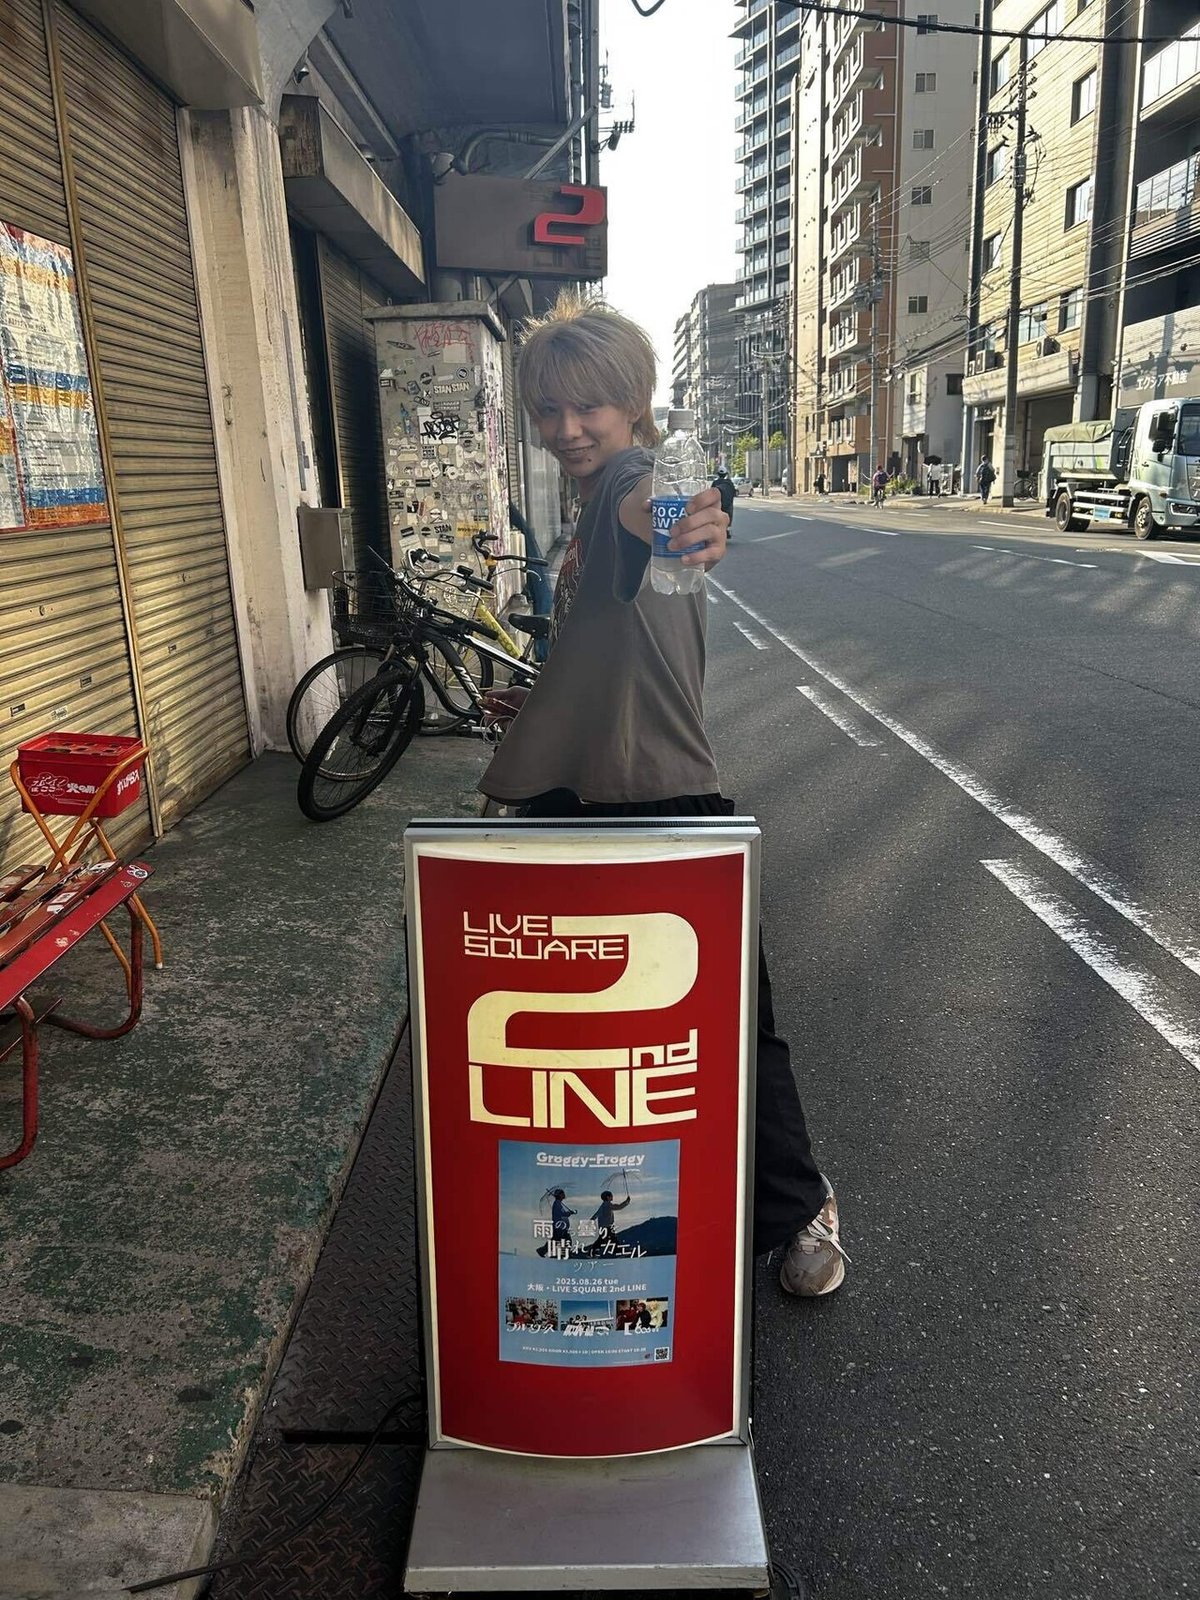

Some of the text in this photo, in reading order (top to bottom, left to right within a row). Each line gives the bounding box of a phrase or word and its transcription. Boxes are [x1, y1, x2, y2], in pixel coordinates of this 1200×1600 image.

[534, 184, 605, 245] 2
[652, 506, 688, 518] POCA
[66, 783, 99, 794] 火の用
[463, 911, 549, 936] LIVE
[464, 935, 625, 960] SQUARE
[468, 1062, 698, 1128] LINE
[536, 1152, 645, 1167] Groggy-Froggy
[572, 1285, 608, 1294] SQUARE
[609, 1284, 626, 1292] 2nd
[627, 1283, 647, 1291] LINE
